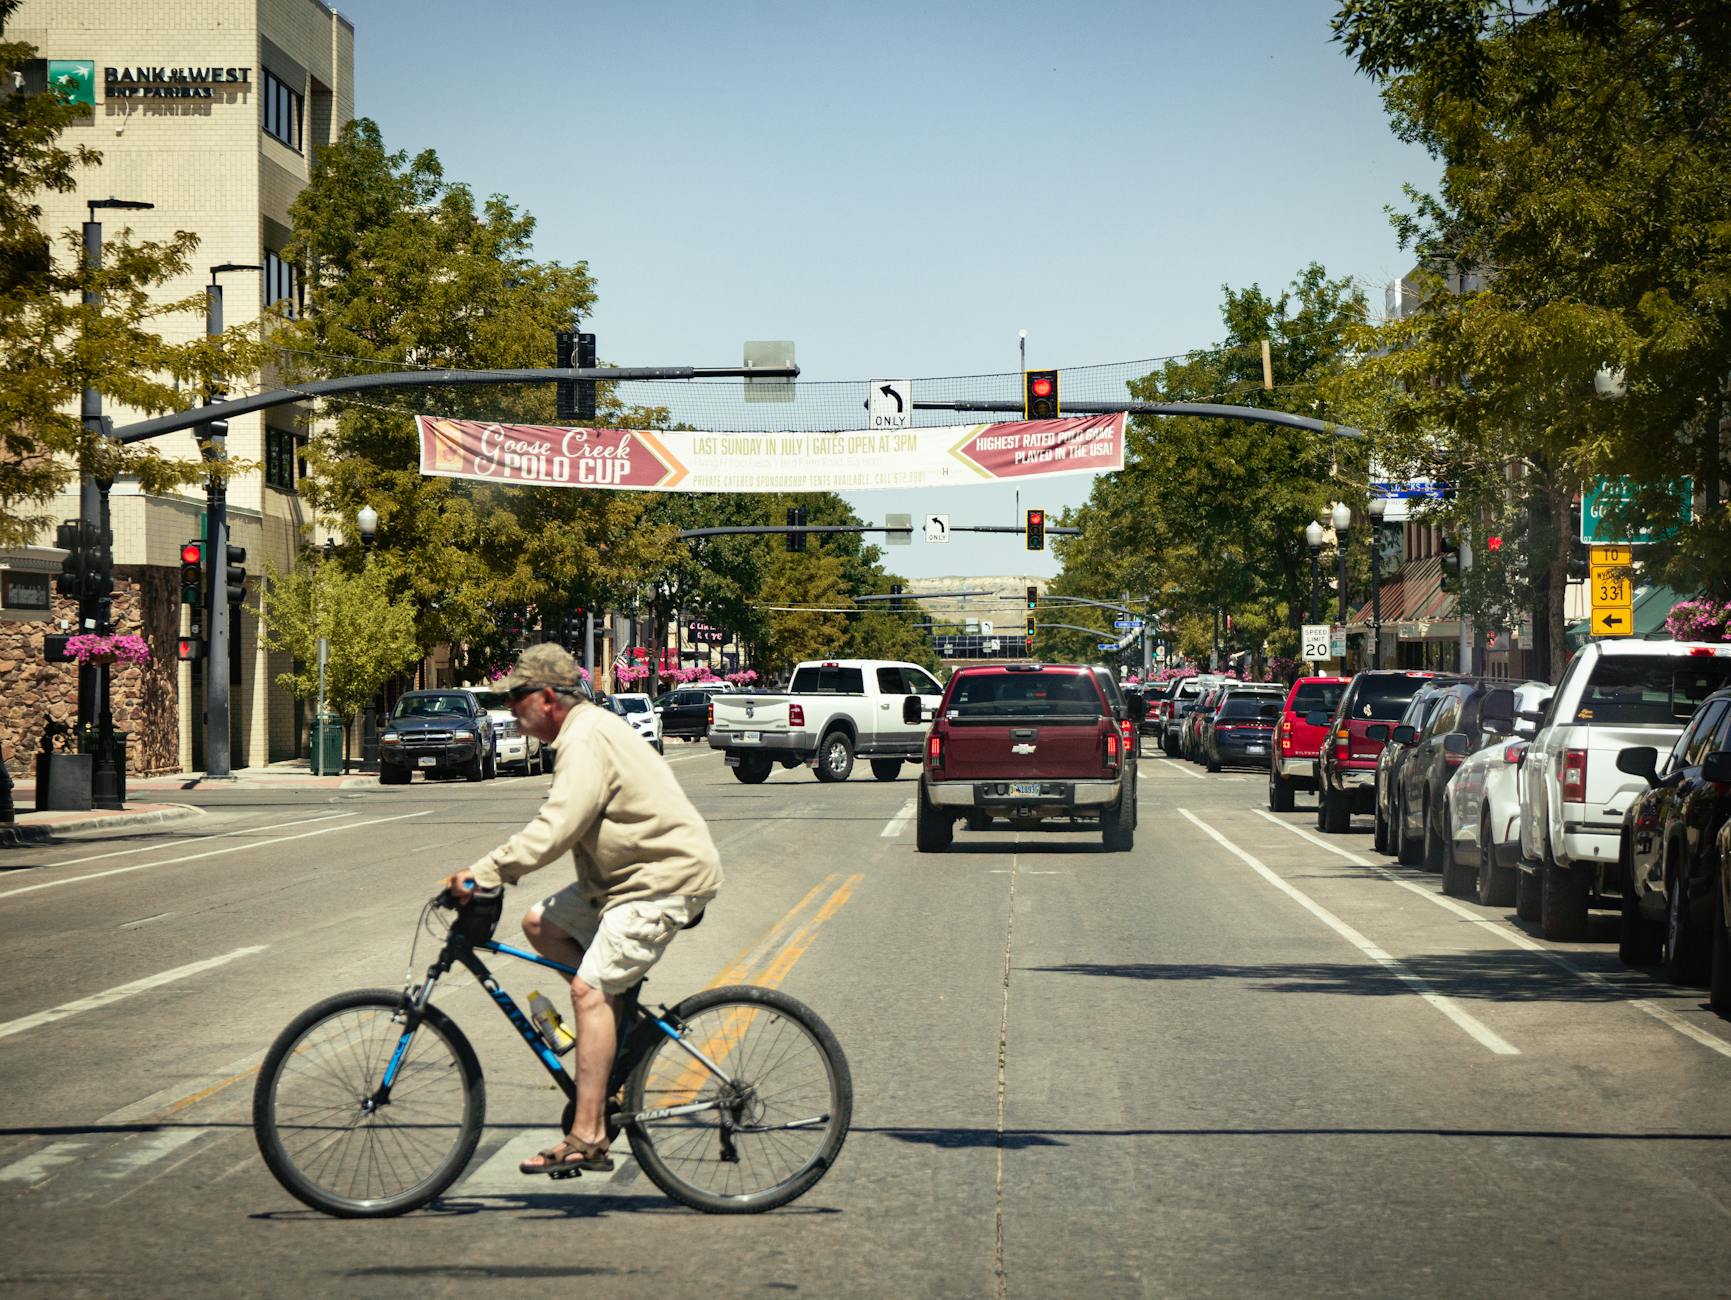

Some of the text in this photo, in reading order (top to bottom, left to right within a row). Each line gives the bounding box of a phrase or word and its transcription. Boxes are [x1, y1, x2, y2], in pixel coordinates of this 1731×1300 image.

[104, 67, 165, 83] BANK
[171, 68, 184, 76] OF
[188, 67, 252, 83] WEST
[105, 87, 214, 98] BNP PARIBAS
[875, 416, 906, 426] ONLY
[693, 433, 918, 456] LAST SUNDAY IN JULY GATES OPEN AT 3PM
[976, 434, 1020, 451] HIGHEST
[1023, 432, 1055, 448] RATED
[1086, 425, 1114, 440] GAME
[474, 424, 631, 476] Goose Creek
[1015, 442, 1113, 465] PLAYED IN THE USA!
[504, 453, 631, 485] POLO CUP
[693, 475, 720, 487] PRIVATE
[724, 475, 753, 487] CATERED
[809, 474, 831, 486] TENTS
[1603, 549, 1619, 561] TO
[1600, 585, 1623, 601] 331
[1306, 644, 1327, 656] 20
